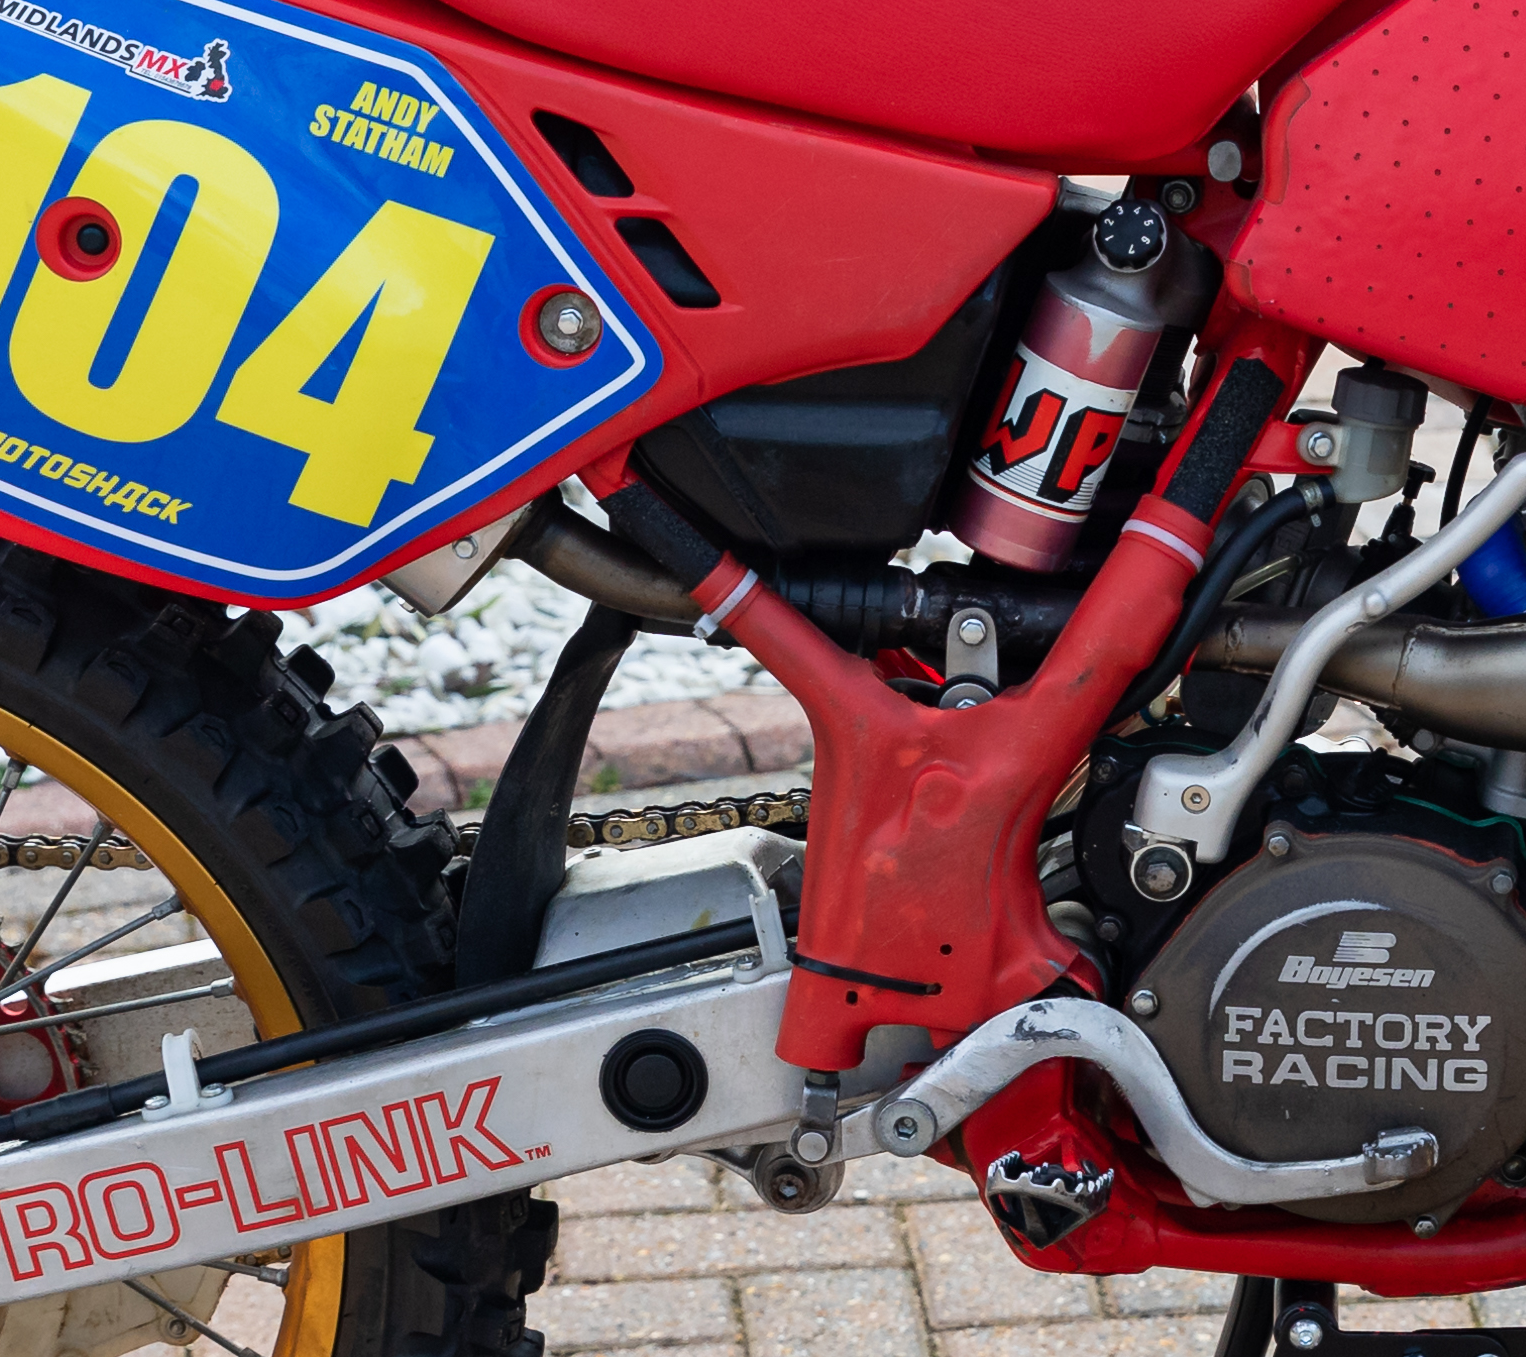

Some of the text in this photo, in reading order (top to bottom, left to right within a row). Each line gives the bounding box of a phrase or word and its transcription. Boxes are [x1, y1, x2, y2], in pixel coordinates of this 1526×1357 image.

[351, 81, 439, 133] ANDY
[309, 104, 454, 177] STATHAM
[1103, 218, 1114, 226] 2
[1116, 205, 1124, 215] 3
[974, 356, 1129, 505] WP
[1277, 955, 1436, 990] Boyesen
[1222, 1004, 1494, 1054] FACTORY
[1221, 1050, 1489, 1094] RACING
